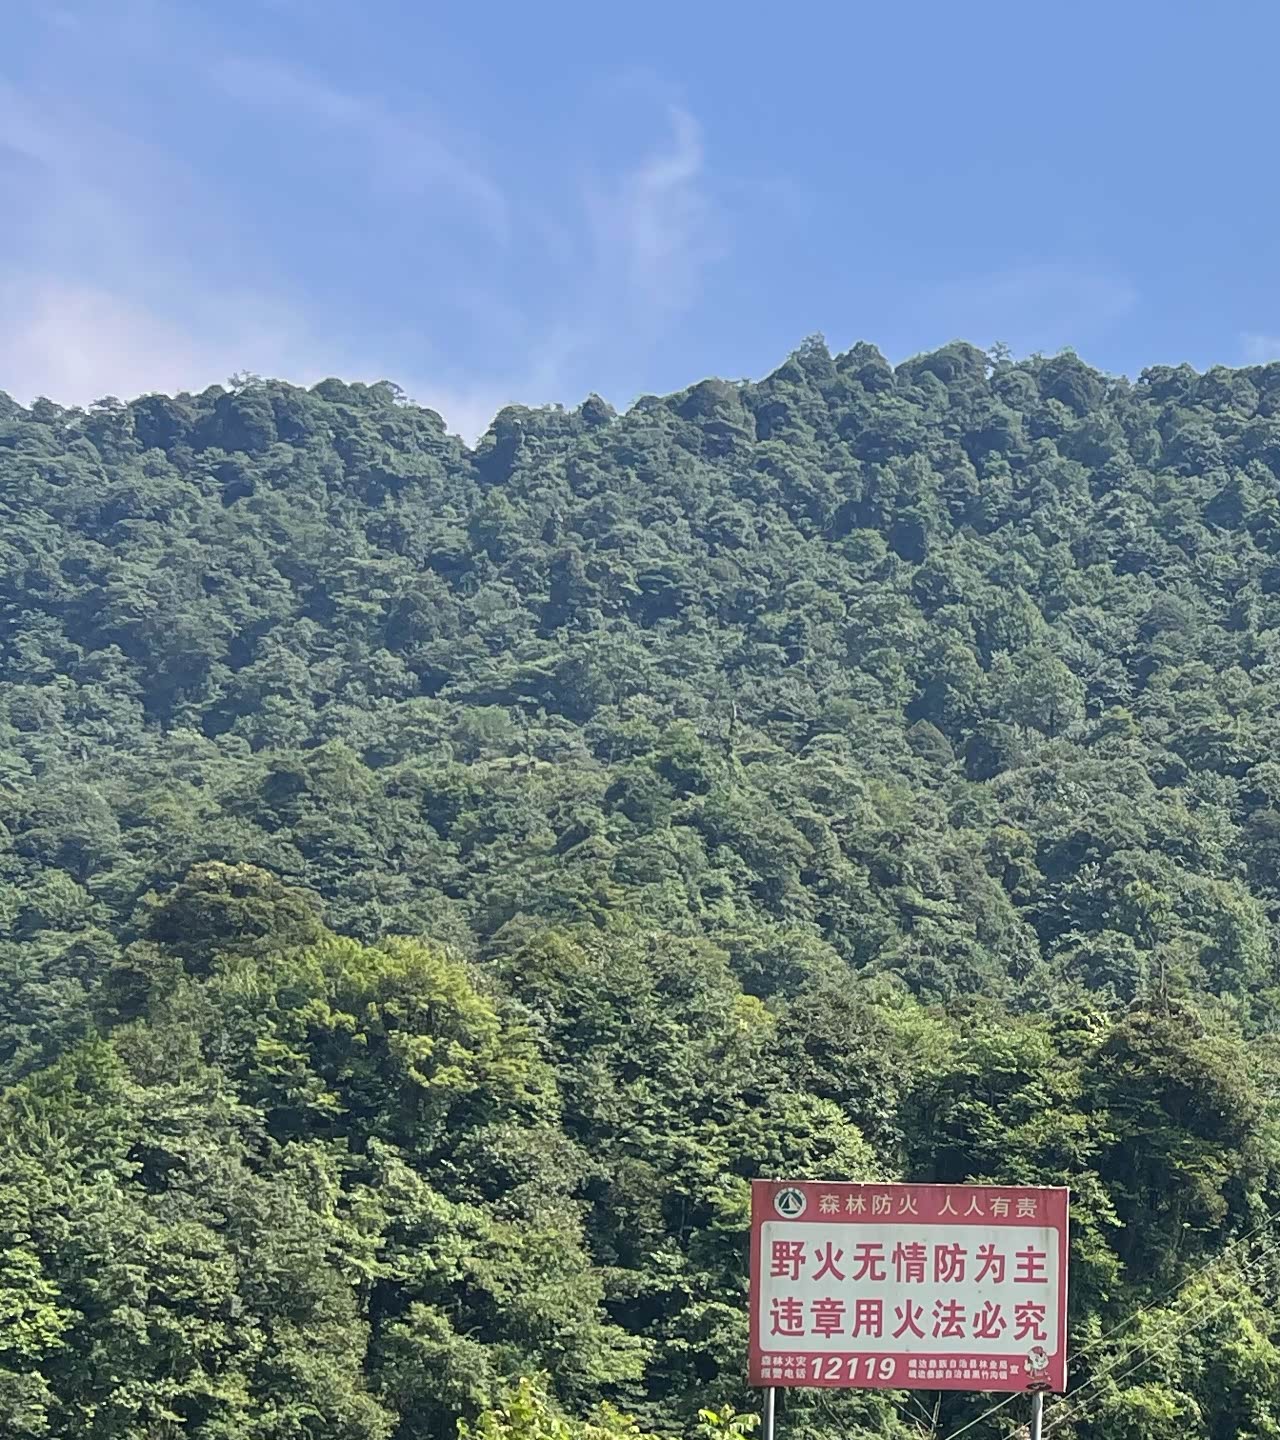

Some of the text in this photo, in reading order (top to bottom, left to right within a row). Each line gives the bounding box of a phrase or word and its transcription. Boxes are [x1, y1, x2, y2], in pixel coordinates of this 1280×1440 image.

[818, 1192, 919, 1216] 森林防火
[937, 1194, 1038, 1219] 人人有责
[769, 1240, 1049, 1286] 野火无情防为主
[769, 1296, 1049, 1342] 违章用火法必究
[811, 1356, 897, 1380] 12119
